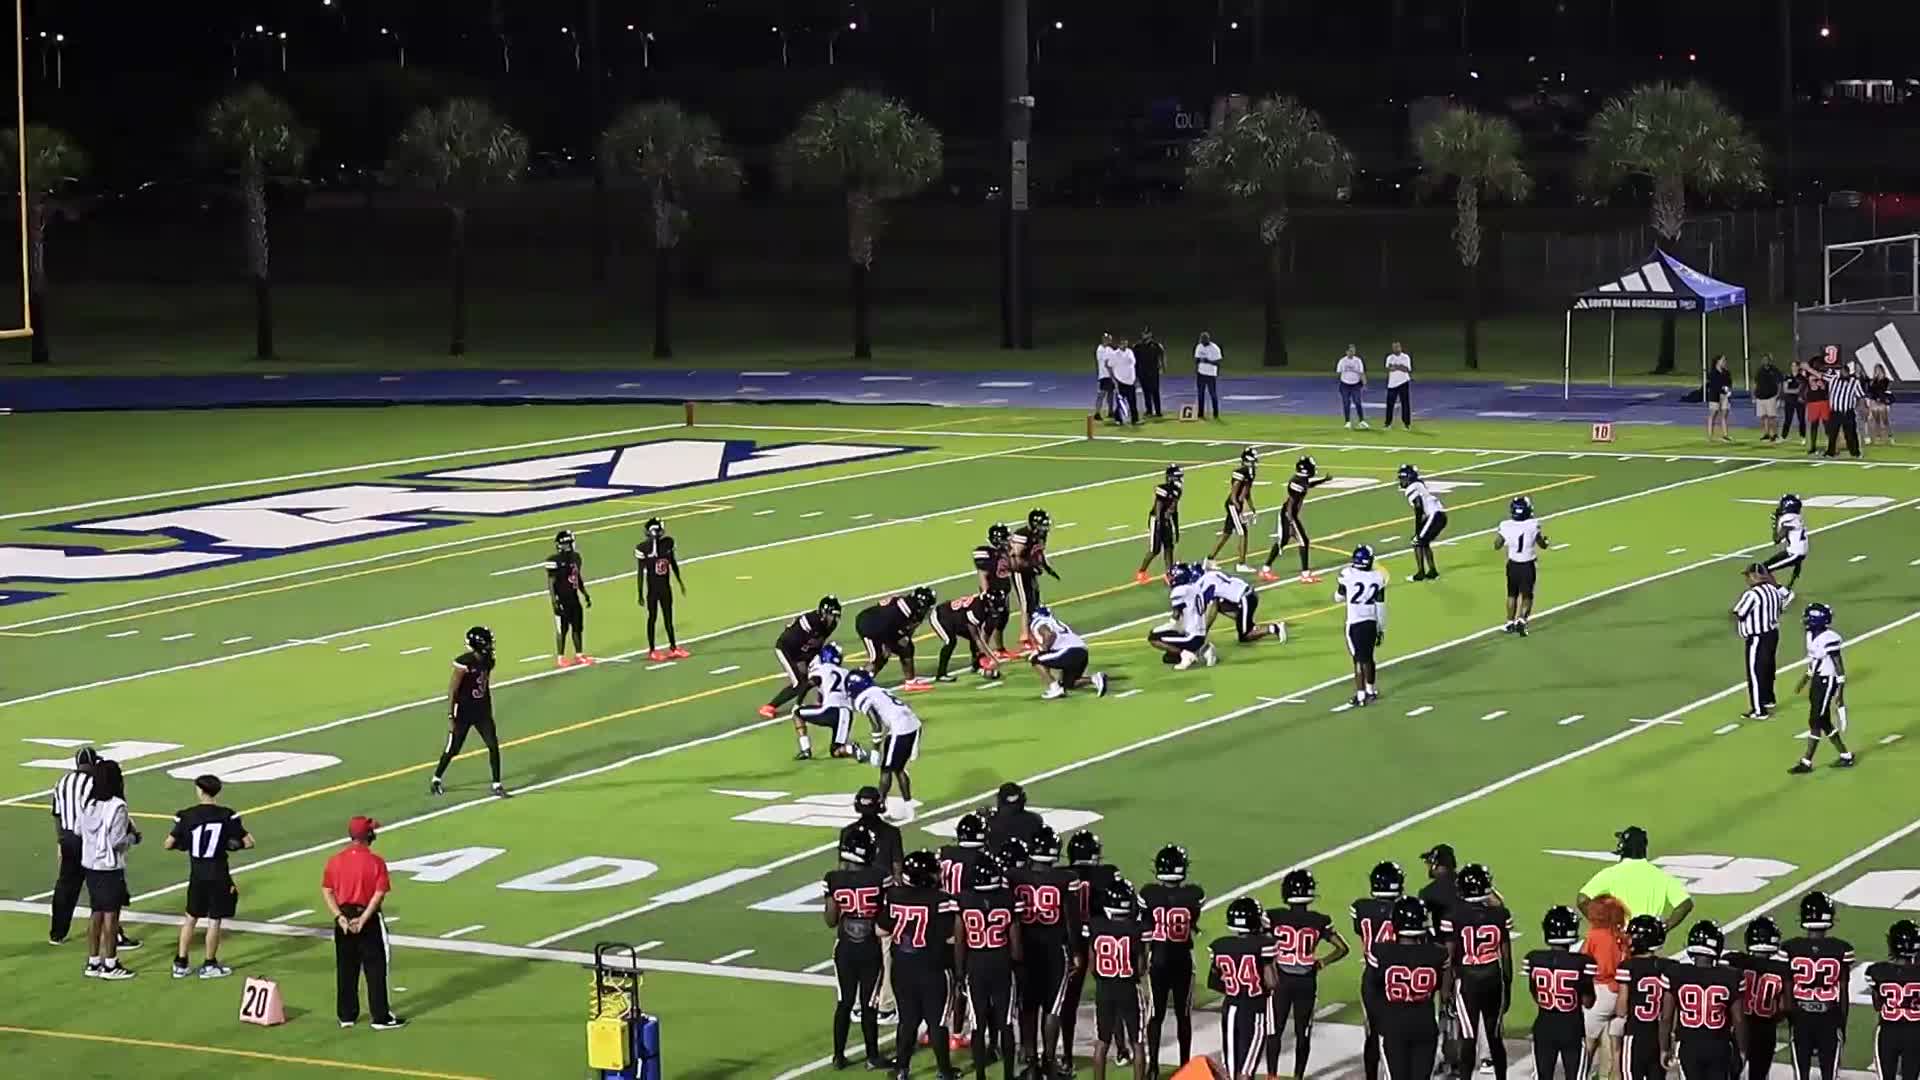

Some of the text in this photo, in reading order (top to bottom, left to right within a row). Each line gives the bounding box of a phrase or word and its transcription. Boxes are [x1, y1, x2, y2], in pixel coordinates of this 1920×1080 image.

[1183, 404, 1193, 419] G
[1594, 425, 1608, 439] 10
[1516, 532, 1525, 554] 1
[1350, 581, 1380, 605] 22
[190, 822, 223, 859] 17
[833, 886, 880, 918] 25
[889, 903, 928, 948] 77
[962, 908, 1011, 949] 82
[1461, 924, 1501, 965] 12
[1093, 935, 1133, 978] 81
[1274, 925, 1320, 966] 20
[1384, 965, 1438, 1003] 69
[1532, 966, 1580, 1012] 85
[1791, 956, 1840, 1002] 23
[242, 985, 268, 1018] 20
[1678, 984, 1730, 1030] 96
